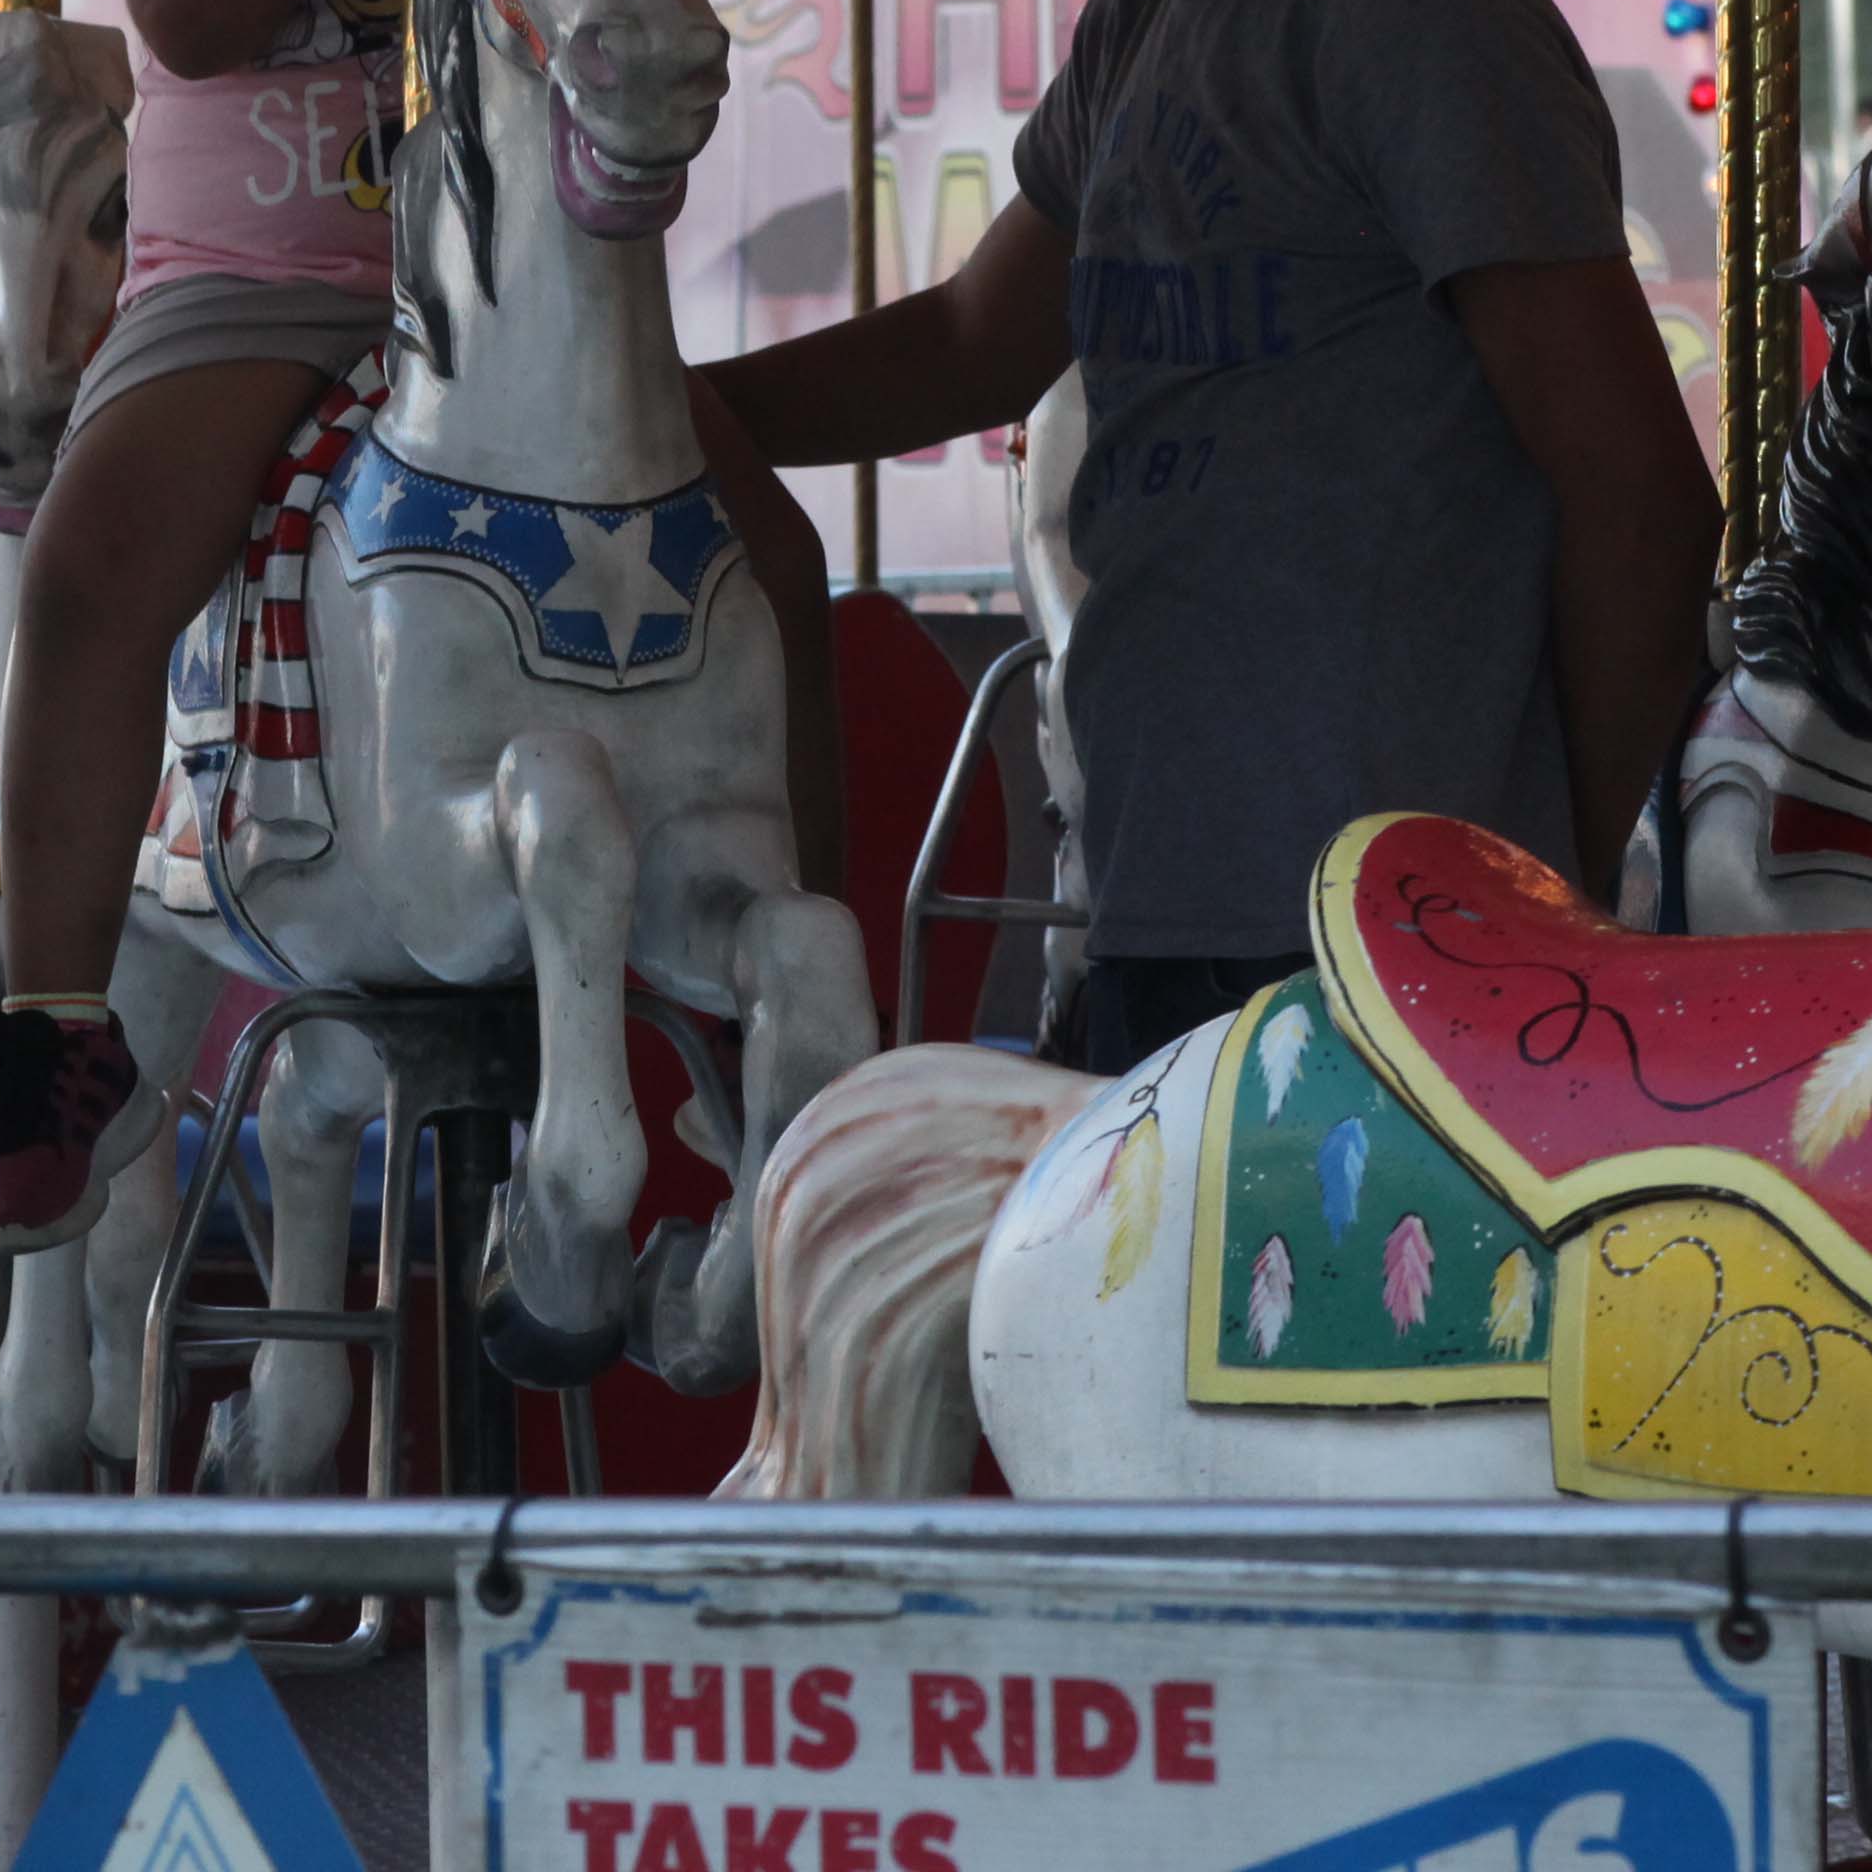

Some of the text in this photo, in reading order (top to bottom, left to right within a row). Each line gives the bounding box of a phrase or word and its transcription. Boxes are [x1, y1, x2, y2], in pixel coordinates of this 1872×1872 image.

[564, 1660, 1218, 1785] THIS RIDE
[566, 1798, 963, 1872] TAKES
